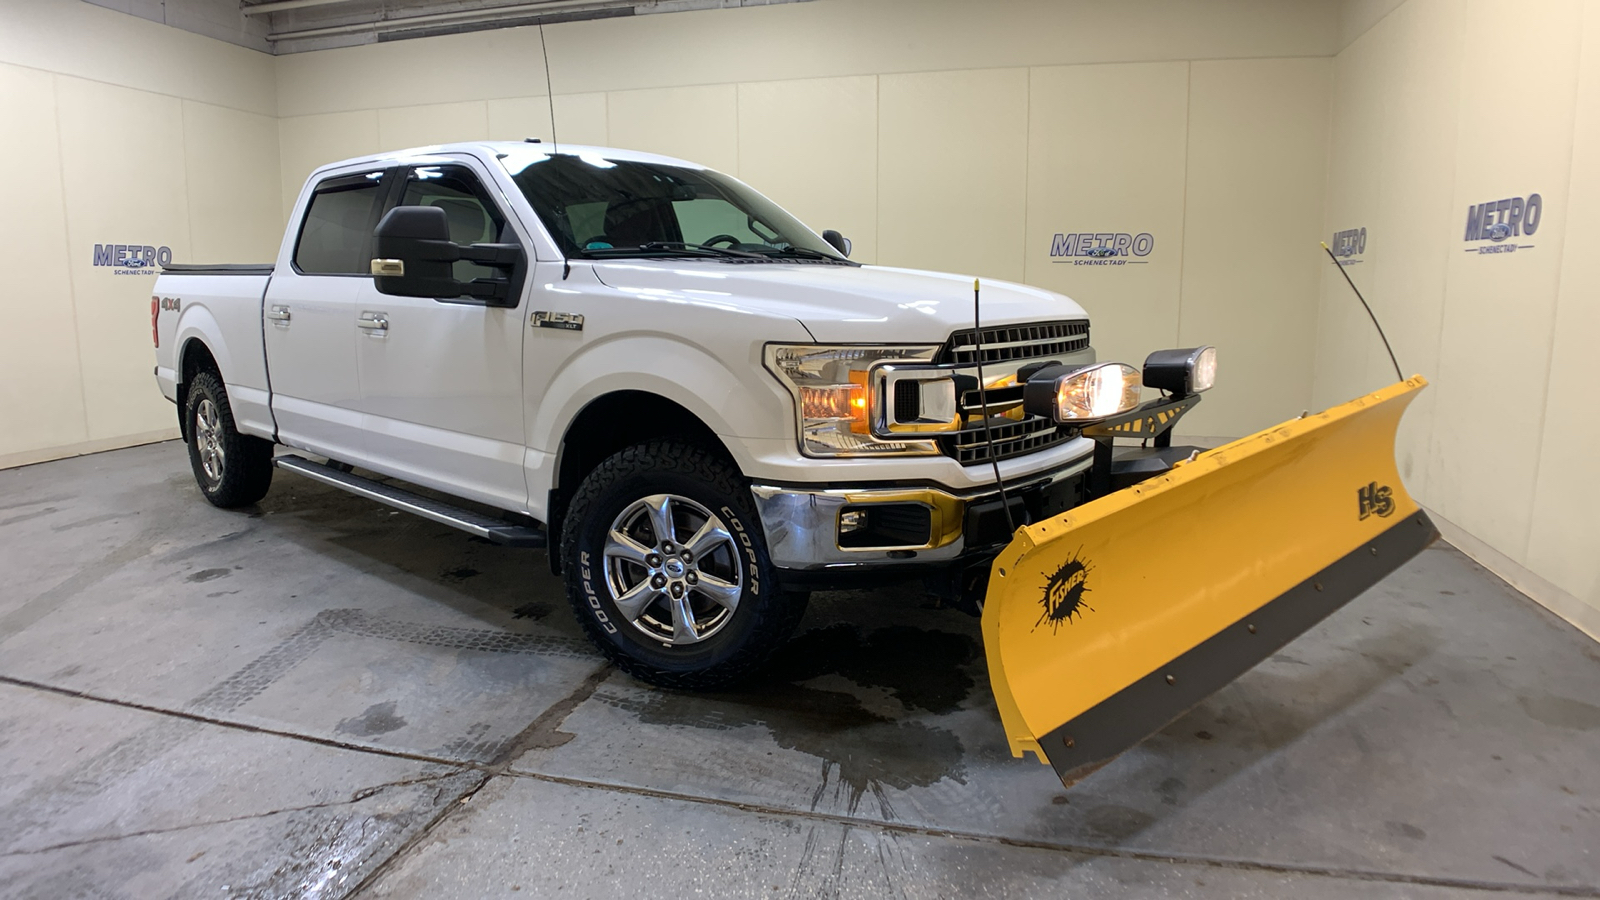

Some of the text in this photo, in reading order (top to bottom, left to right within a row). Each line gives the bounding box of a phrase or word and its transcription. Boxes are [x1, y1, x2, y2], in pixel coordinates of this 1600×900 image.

[1464, 193, 1542, 241] METRO
[93, 244, 172, 267] METRO
[1050, 233, 1154, 256] METRO
[1332, 226, 1367, 257] METRO
[721, 506, 759, 596] COOPER
[580, 550, 618, 635] COOPER
[1049, 569, 1085, 616] FISHER
